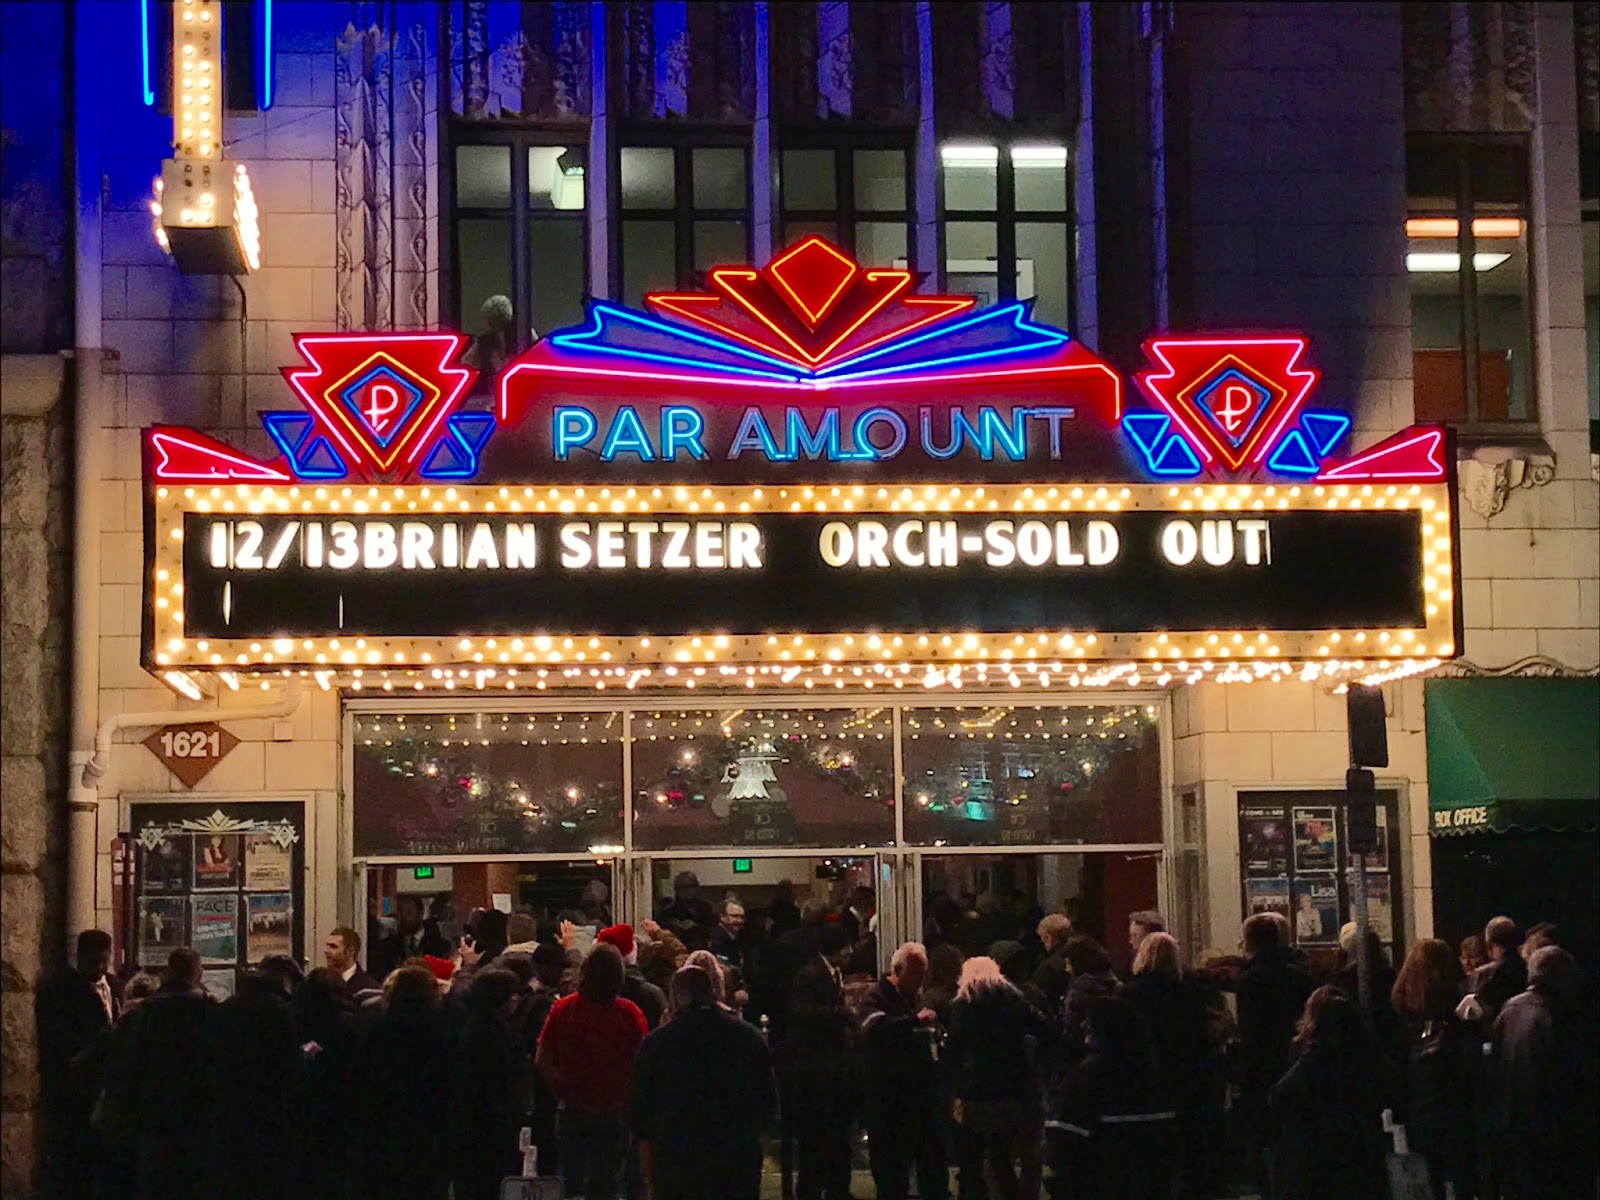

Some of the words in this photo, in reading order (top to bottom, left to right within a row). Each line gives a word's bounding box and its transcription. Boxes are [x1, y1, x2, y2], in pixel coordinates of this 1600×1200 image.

[559, 521, 764, 568] SETZER
[1161, 519, 1271, 567] OUT
[160, 730, 220, 758] 1621
[1453, 806, 1487, 826] OFFICE
[196, 899, 235, 912] FACE
